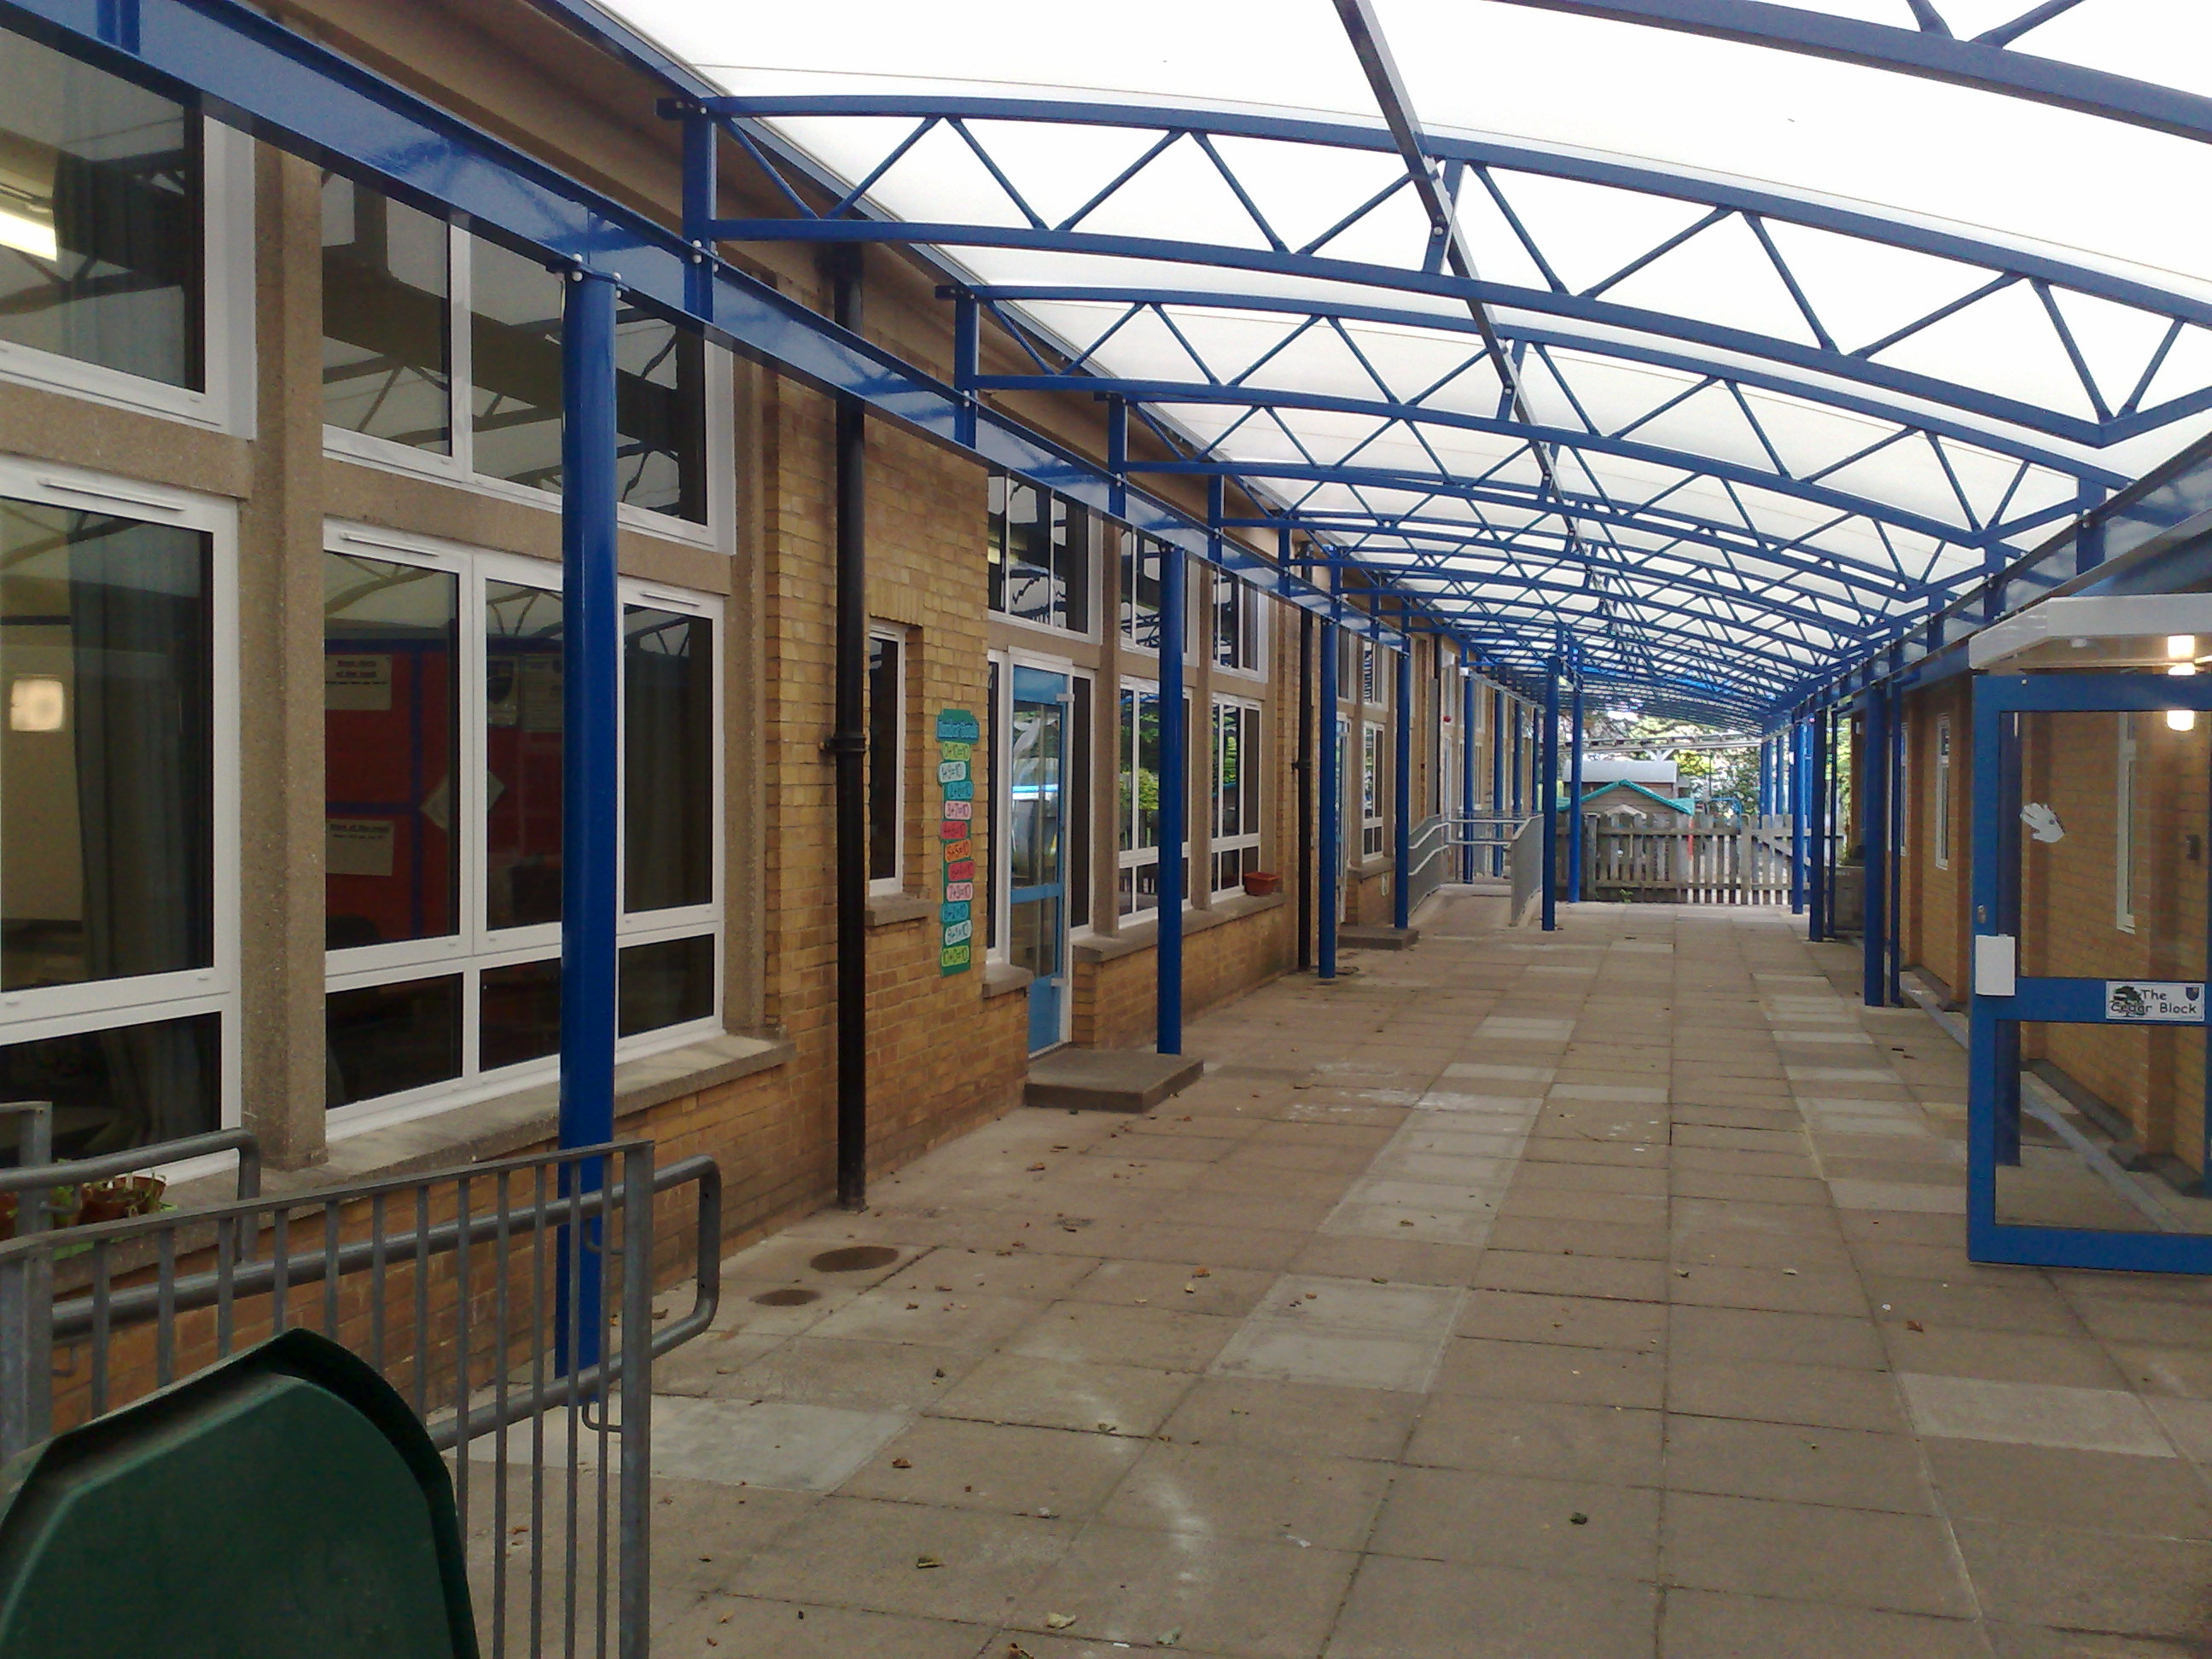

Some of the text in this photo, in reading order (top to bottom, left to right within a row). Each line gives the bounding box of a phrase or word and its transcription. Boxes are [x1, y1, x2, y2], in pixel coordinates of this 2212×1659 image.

[947, 803, 969, 818] 3+7=10
[2139, 989, 2168, 1000] The
[2110, 1001, 2197, 1014] Cedar Block
